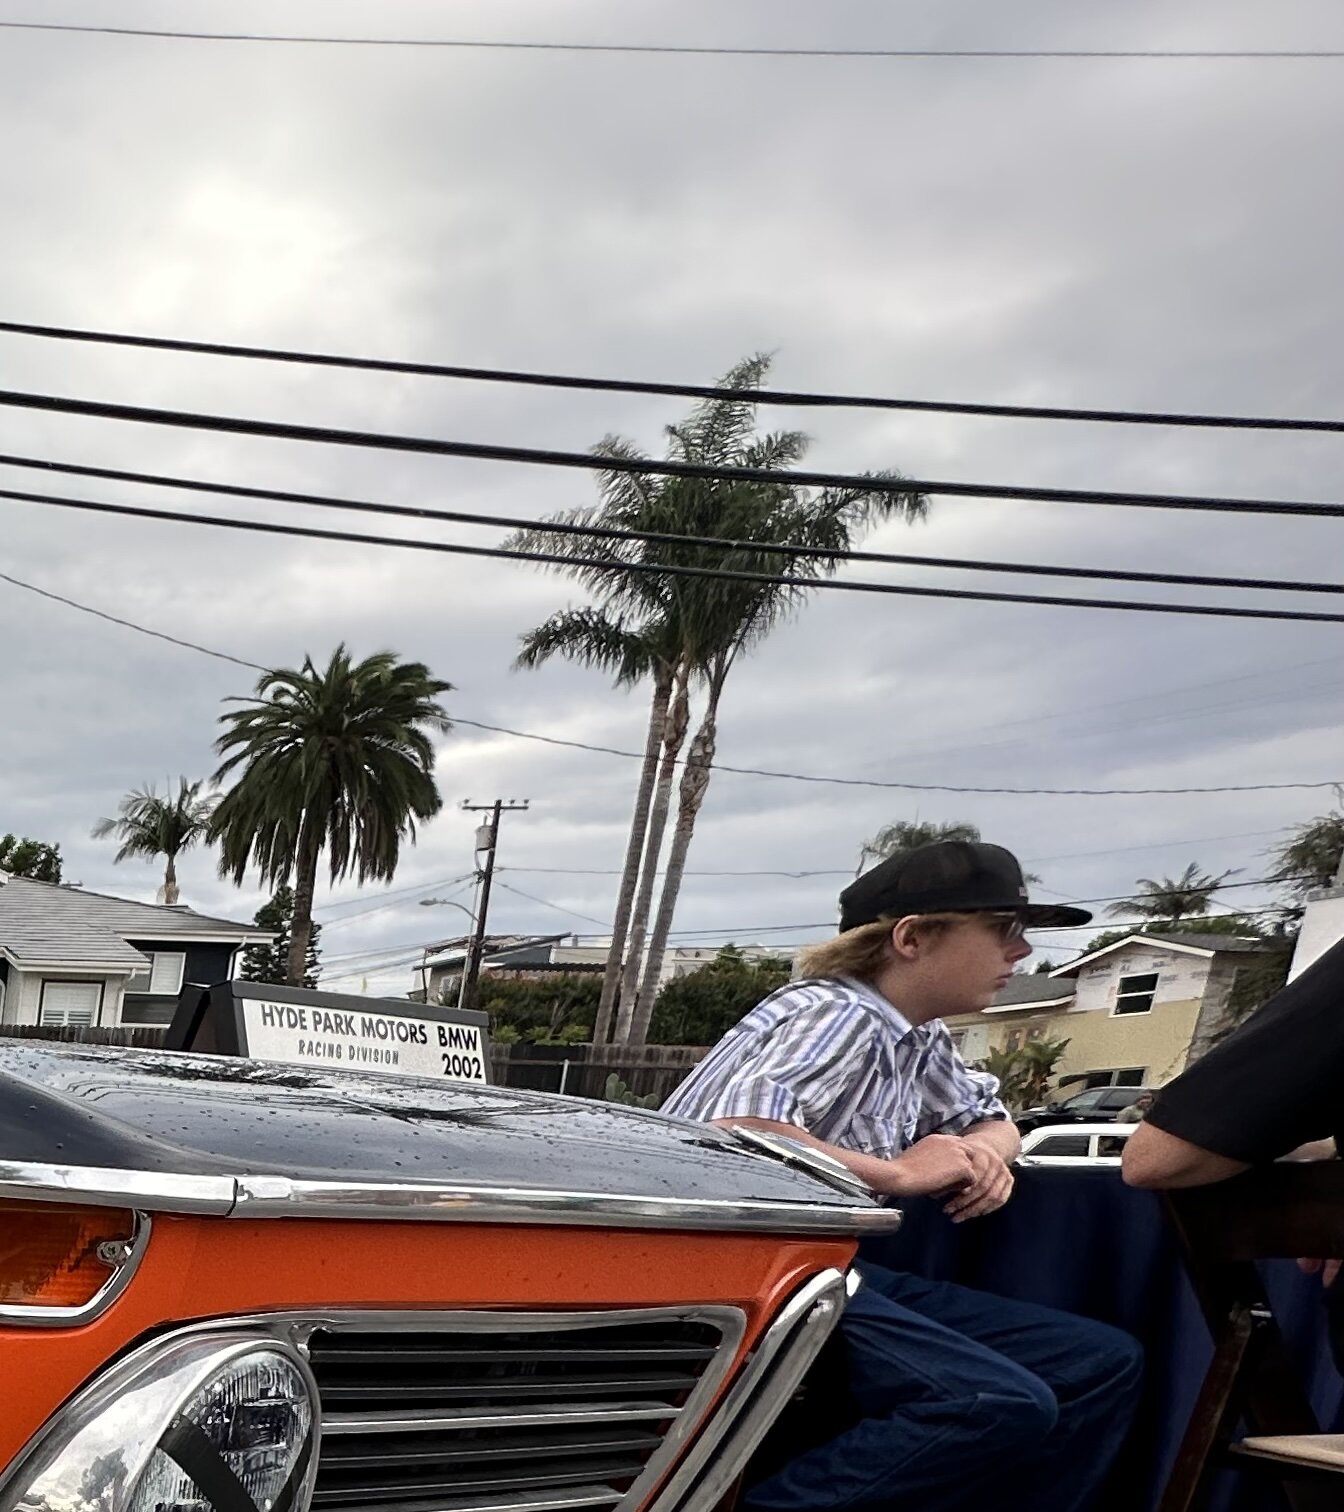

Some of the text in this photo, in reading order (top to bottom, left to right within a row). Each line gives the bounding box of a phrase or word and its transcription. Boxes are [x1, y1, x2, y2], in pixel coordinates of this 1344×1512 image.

[260, 1003, 478, 1051] HYDE PARK MOTORS BMW
[298, 1039, 482, 1079] RACING DIVISION 2002
